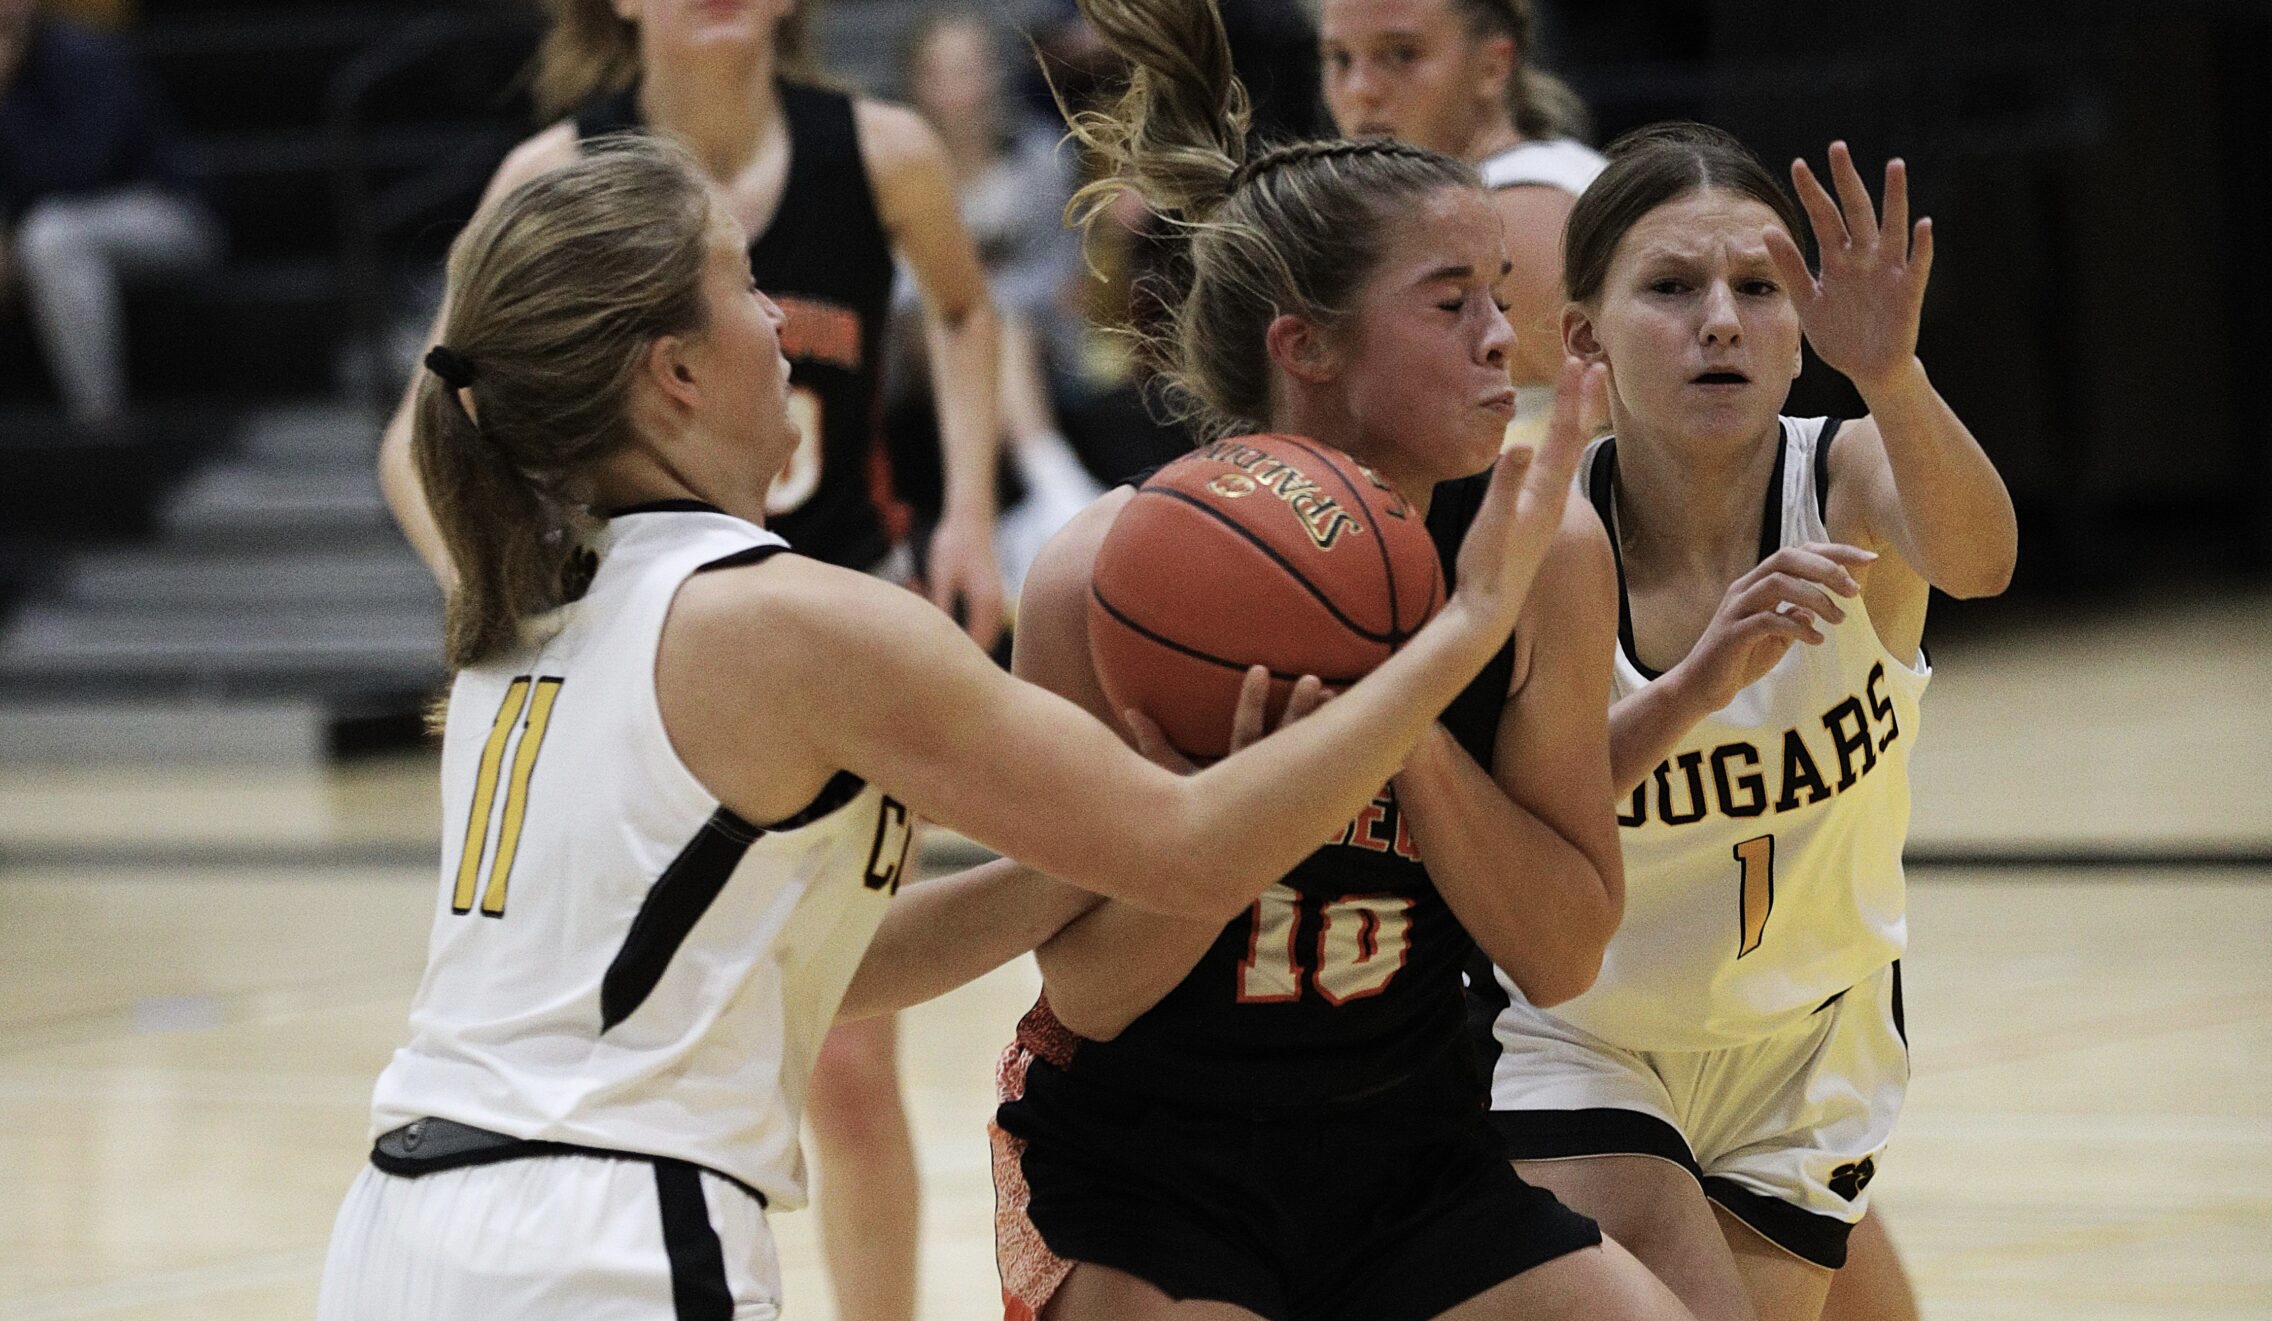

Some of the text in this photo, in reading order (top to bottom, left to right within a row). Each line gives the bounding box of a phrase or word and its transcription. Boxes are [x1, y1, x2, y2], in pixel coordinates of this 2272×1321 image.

[452, 675, 565, 919] 11
[864, 795, 912, 896] C
[1236, 883, 1415, 1007] 10
[1733, 834, 1775, 960] 1
